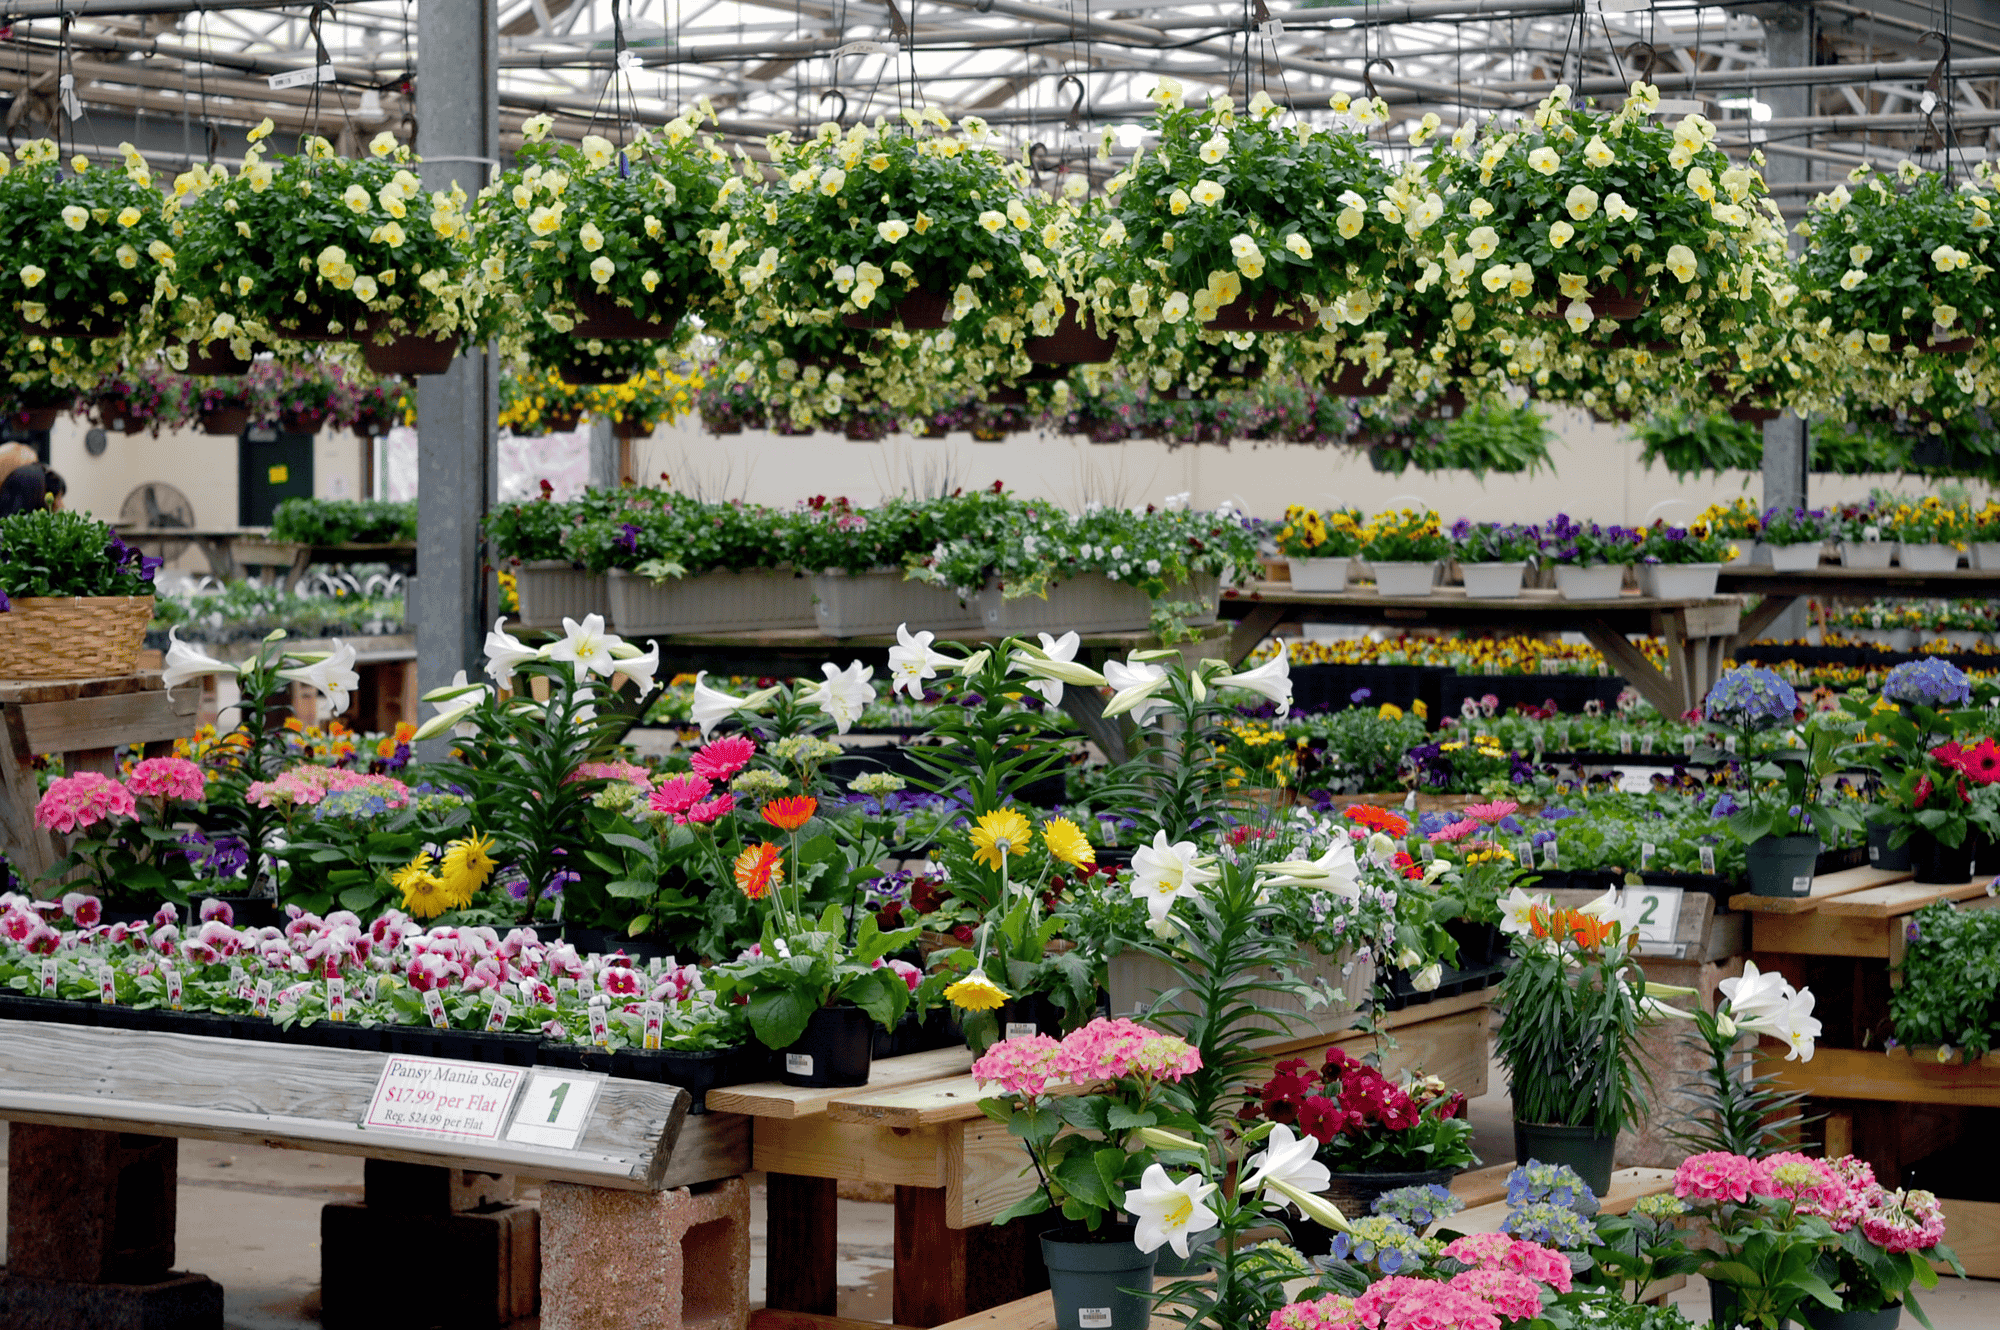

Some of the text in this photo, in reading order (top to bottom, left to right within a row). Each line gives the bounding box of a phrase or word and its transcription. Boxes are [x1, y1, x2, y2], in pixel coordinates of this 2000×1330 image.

[1638, 896, 1659, 924] 2
[390, 1062, 512, 1088] Pansy Mania Sale
[385, 1086, 497, 1112] $17.99 per Flat
[547, 1082, 570, 1123] 1
[385, 1109, 483, 1130] Reg. $24.99 per Flat
